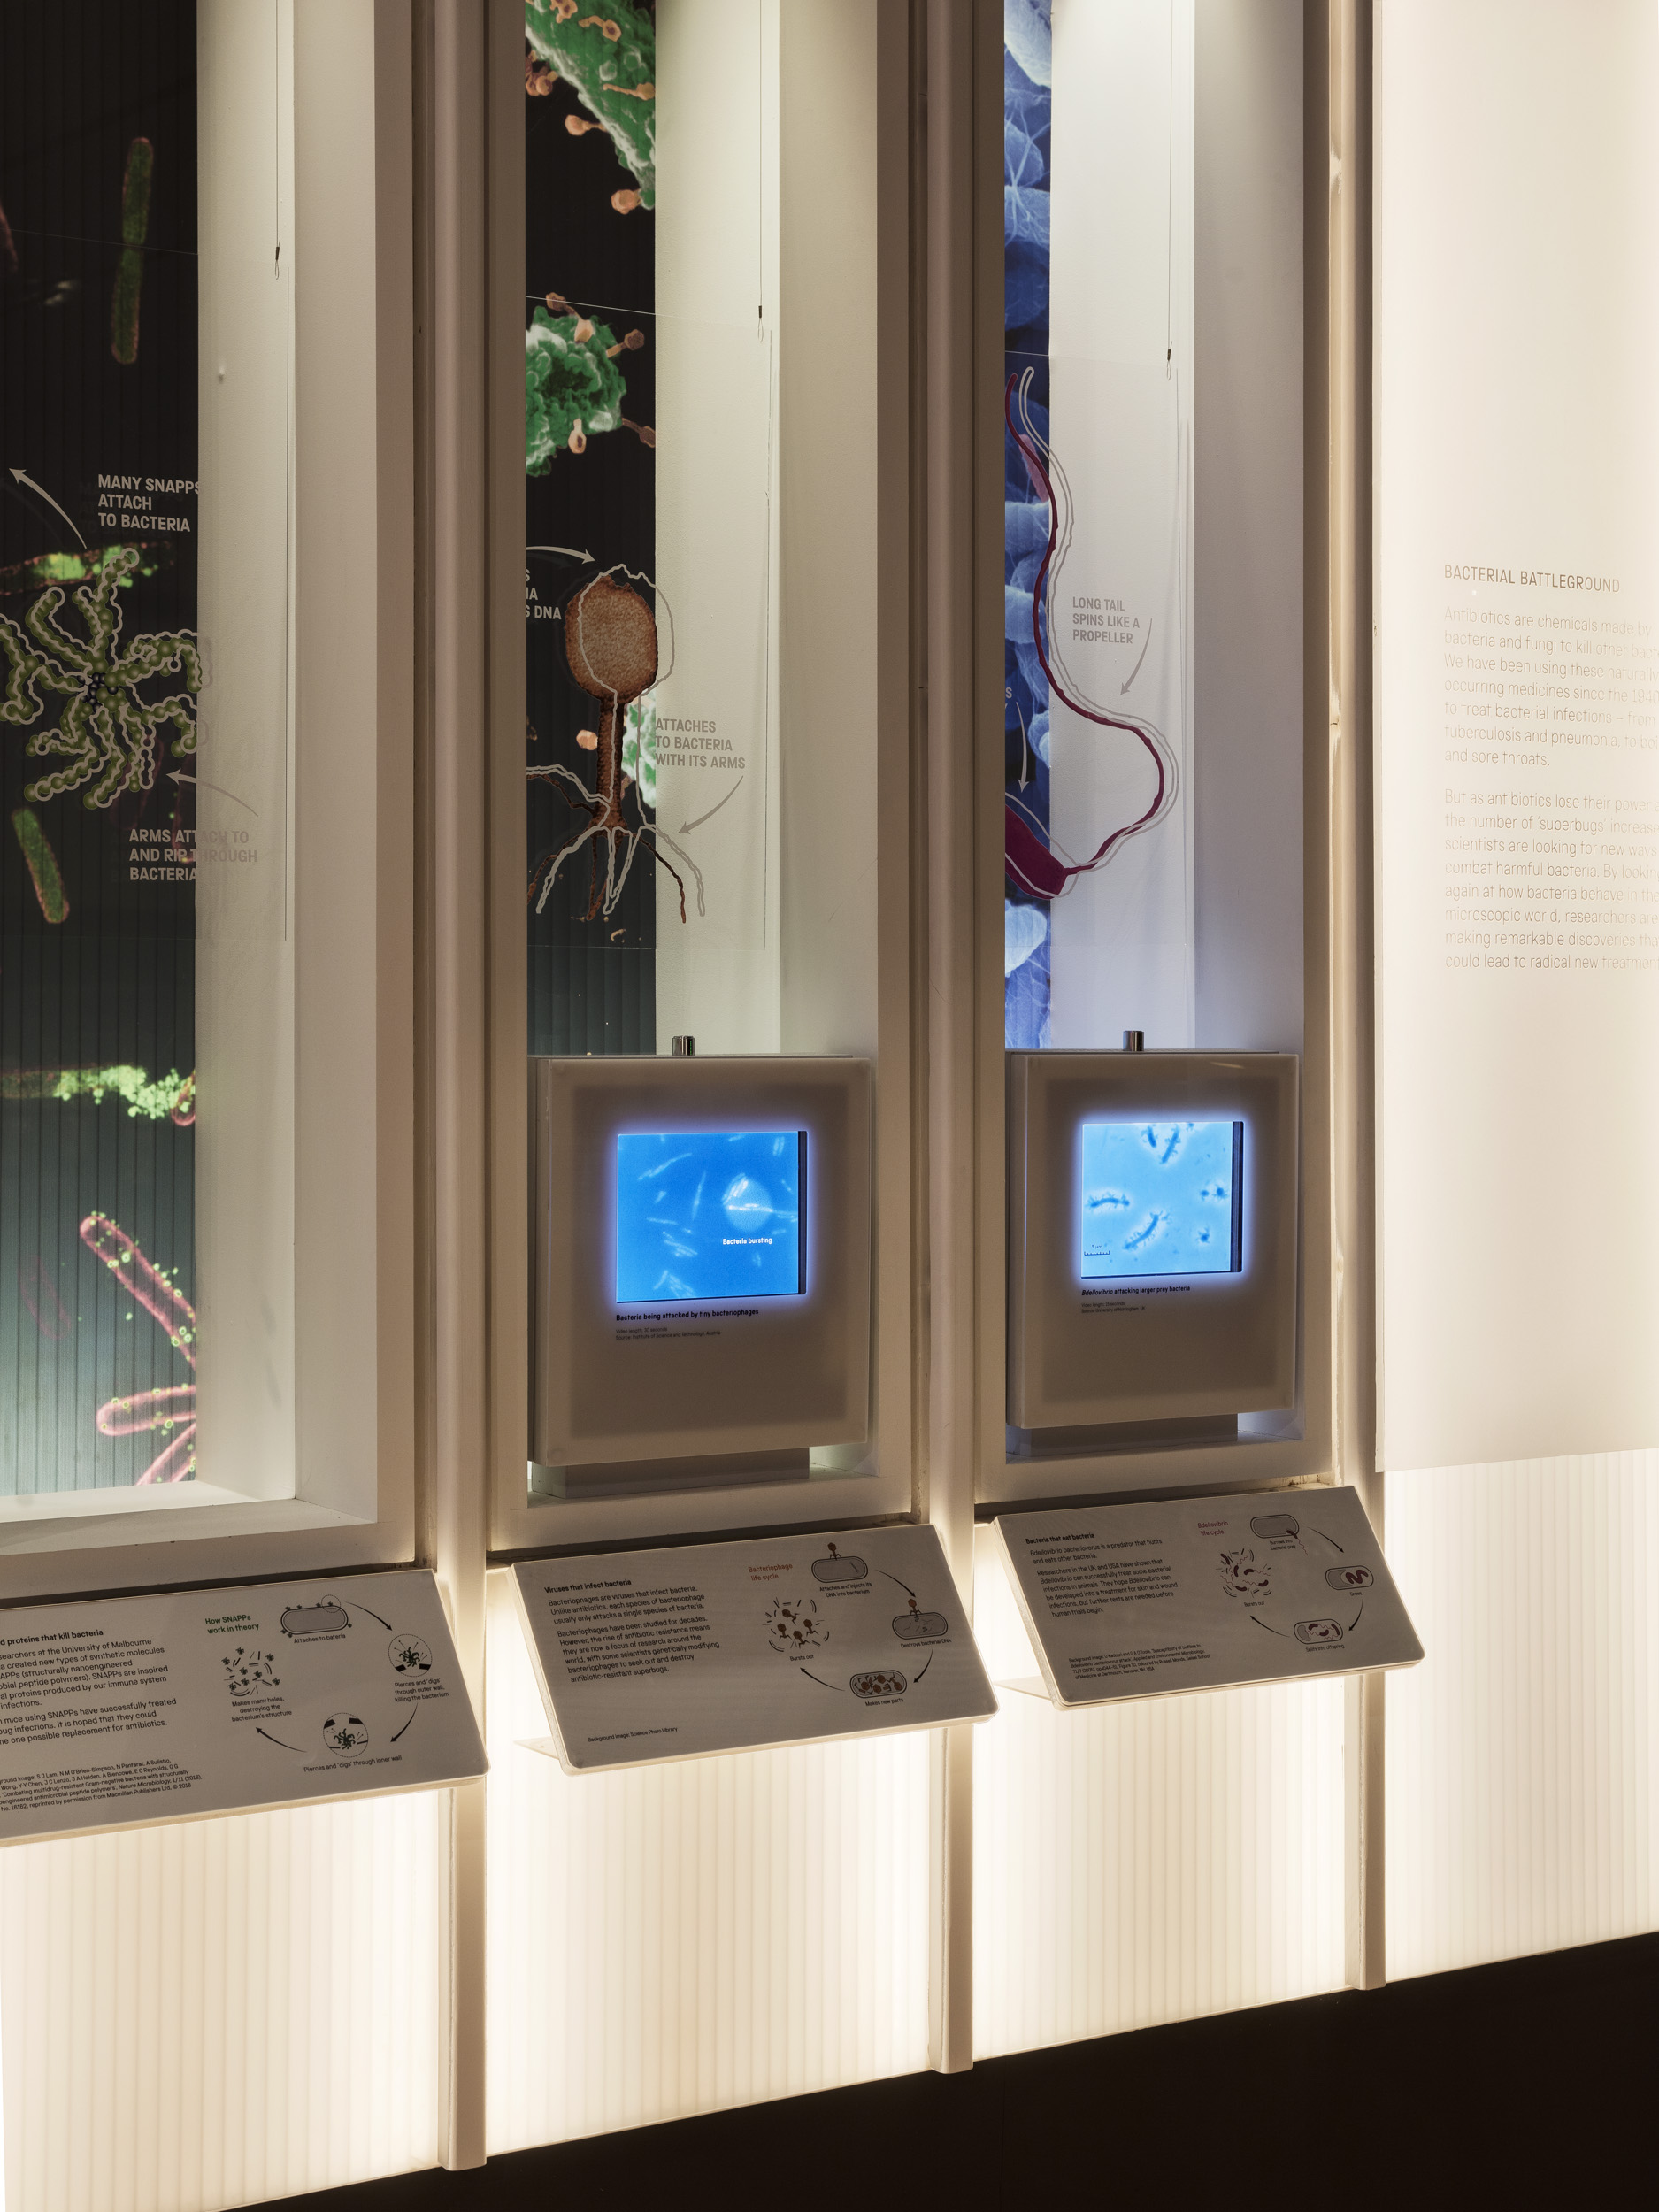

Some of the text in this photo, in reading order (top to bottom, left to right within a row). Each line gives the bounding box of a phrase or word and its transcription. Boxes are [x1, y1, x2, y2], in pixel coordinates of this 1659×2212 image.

[98, 474, 142, 490] MANY
[98, 494, 152, 511] ATTACH
[98, 513, 190, 532] TO BACTERIA
[1445, 565, 1620, 591] BACTERIAL BATTLEGROUND
[1072, 596, 1125, 611] LONG TAIL
[534, 605, 562, 619] DNA
[1072, 613, 1140, 628] SPINS LIKE A
[1445, 607, 1650, 640] Antibiotics are chemicals made by
[1072, 630, 1133, 644] PROPELLER
[1445, 630, 1625, 657] bacteria and fungi to kill other
[1445, 653, 1463, 668] We
[1467, 654, 1496, 670] have
[1500, 657, 1531, 672] been
[1534, 659, 1567, 678] using
[1571, 660, 1604, 676] these
[1445, 679, 1504, 697] occurring
[1508, 681, 1571, 698] medicines
[1573, 684, 1605, 700] since
[1609, 686, 1628, 701] the
[1445, 700, 1655, 726] to treat bacterial infections from
[656, 718, 717, 733] ATTACHES
[656, 735, 733, 751] TO BACTERIA
[1445, 723, 1521, 741] tuberculosis
[1525, 728, 1548, 742] and
[1551, 732, 1620, 750] pneumonia,
[1625, 733, 1637, 748] to
[656, 754, 746, 770] WITH ITS ARMS
[1445, 748, 1549, 765] and sore throats.
[1445, 788, 1649, 814] But as antibiotics lose their power
[1446, 812, 1465, 827] the
[1470, 814, 1517, 829] number
[1521, 815, 1532, 830] of
[128, 829, 250, 843] ARMS ATTACH TO
[129, 848, 258, 863] AND RIP THROUGH
[1446, 836, 1656, 860] scientists are looking for new ways
[129, 867, 197, 881] BACTERIA
[1446, 860, 1617, 881] combat harmful bacteria. By
[748, 1236, 772, 1245] bursting
[1114, 1286, 1139, 1294] attacking
[1140, 1286, 1155, 1294] larger
[616, 1308, 759, 1322] Bacteria being attacked by tiny bacteriophages
[1025, 1535, 1049, 1544] Bacteria
[1071, 1531, 1094, 1540] bacteria
[1210, 1527, 1224, 1537] cycle
[749, 1563, 793, 1573] Bacteriophage
[762, 1571, 779, 1581] cycle
[569, 1582, 583, 1591] that
[584, 1580, 603, 1589] infect
[603, 1578, 632, 1587] bacteria
[549, 1595, 599, 1606] Bacteriophages
[636, 1588, 649, 1597] that
[650, 1586, 668, 1596] infect
[670, 1585, 697, 1594] bacteria.
[205, 1613, 251, 1625] How SNAPPs
[207, 1623, 259, 1634] work in theory
[7, 1635, 40, 1647] proteins
[42, 1632, 57, 1641] that
[72, 1629, 104, 1639] bacteria
[294, 1635, 319, 1644] Attaches
[326, 1632, 346, 1640] bateria
[38, 1639, 152, 1656] at the University of Melbourne
[27, 1732, 60, 1743] possible
[62, 1725, 111, 1738] replacement
[126, 1720, 167, 1730] antibiotics.
